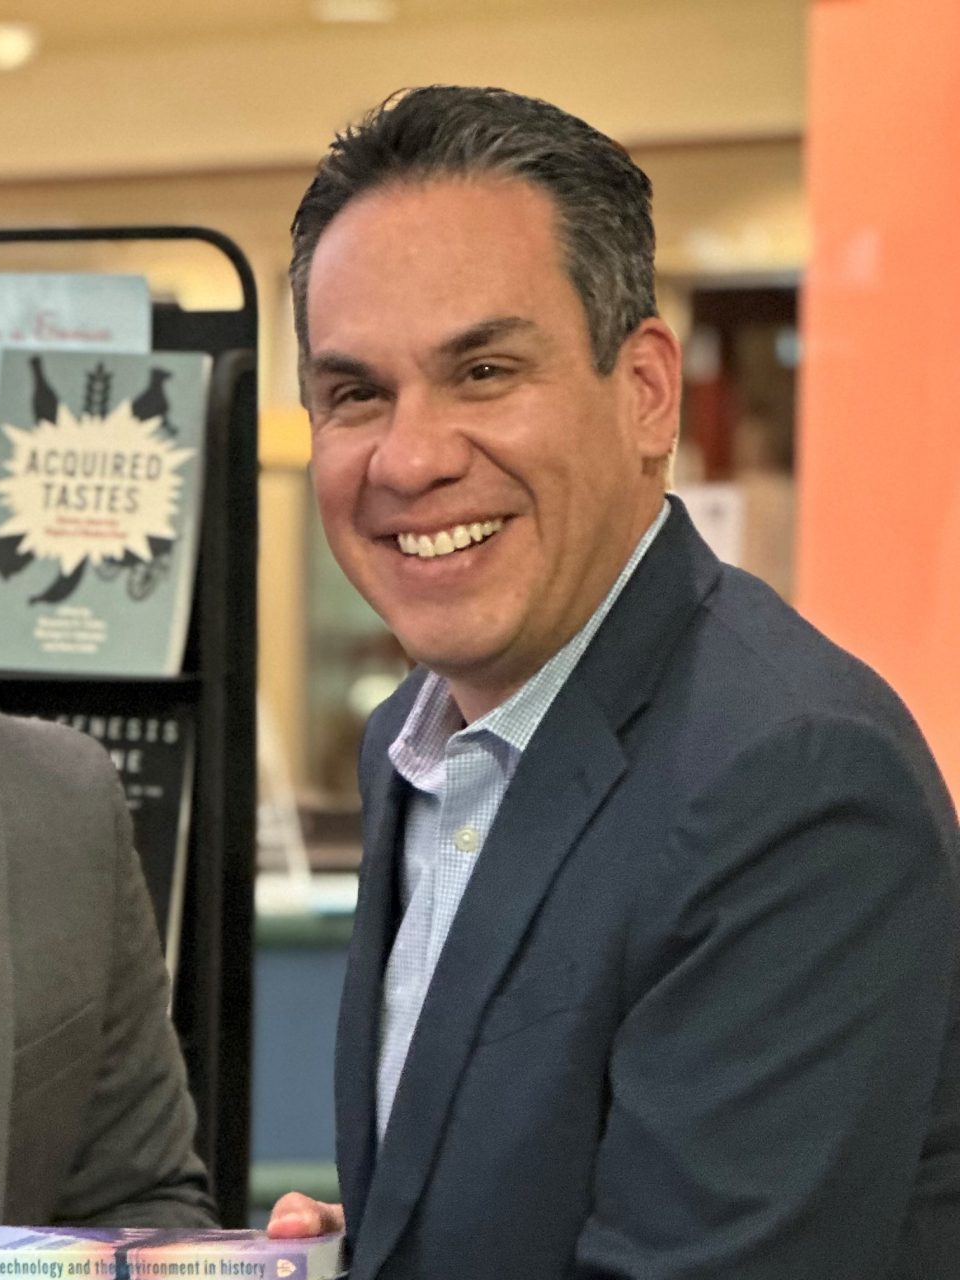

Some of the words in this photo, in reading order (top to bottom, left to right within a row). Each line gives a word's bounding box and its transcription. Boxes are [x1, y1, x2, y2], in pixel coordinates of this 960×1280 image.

[24, 449, 163, 482] ACQUIRED
[42, 481, 140, 513] TASTES
[68, 1259, 90, 1275] and
[95, 1259, 116, 1275] the
[204, 1258, 216, 1275] in
[220, 1258, 265, 1278] history
